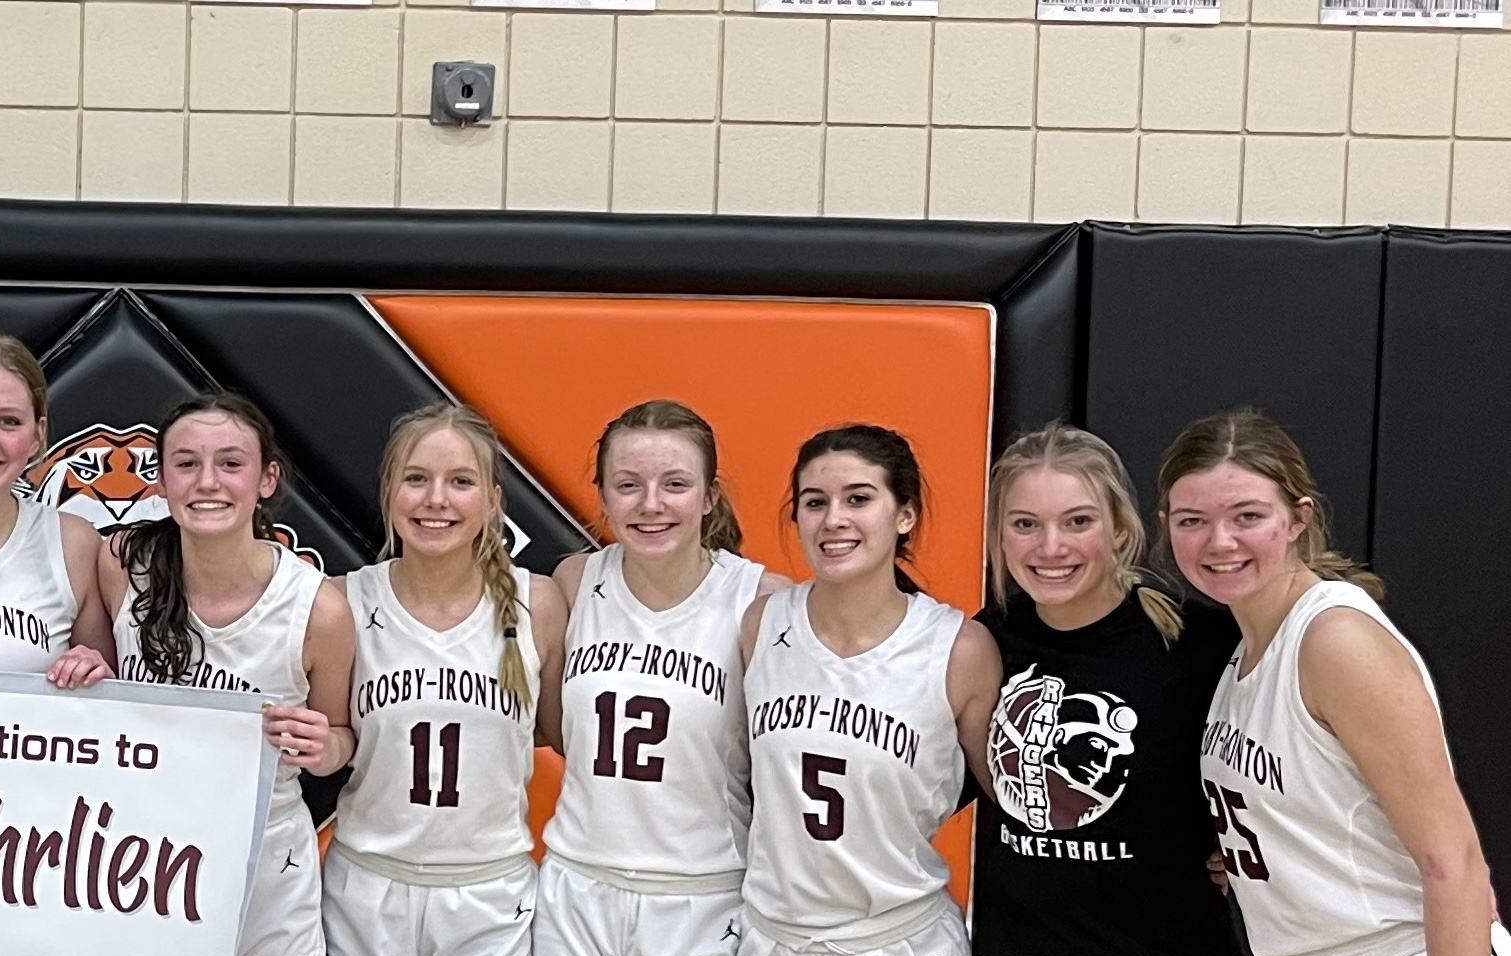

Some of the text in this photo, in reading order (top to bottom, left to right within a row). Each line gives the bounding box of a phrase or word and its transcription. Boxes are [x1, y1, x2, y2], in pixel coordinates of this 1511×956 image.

[564, 641, 728, 707] CROSBY-IRONTON
[115, 734, 160, 770] to
[409, 721, 461, 808] 11
[593, 690, 671, 782] 12
[751, 694, 921, 769] CROSBY-IRONTON
[1022, 677, 1062, 830] RANGERS
[802, 752, 847, 841] 5
